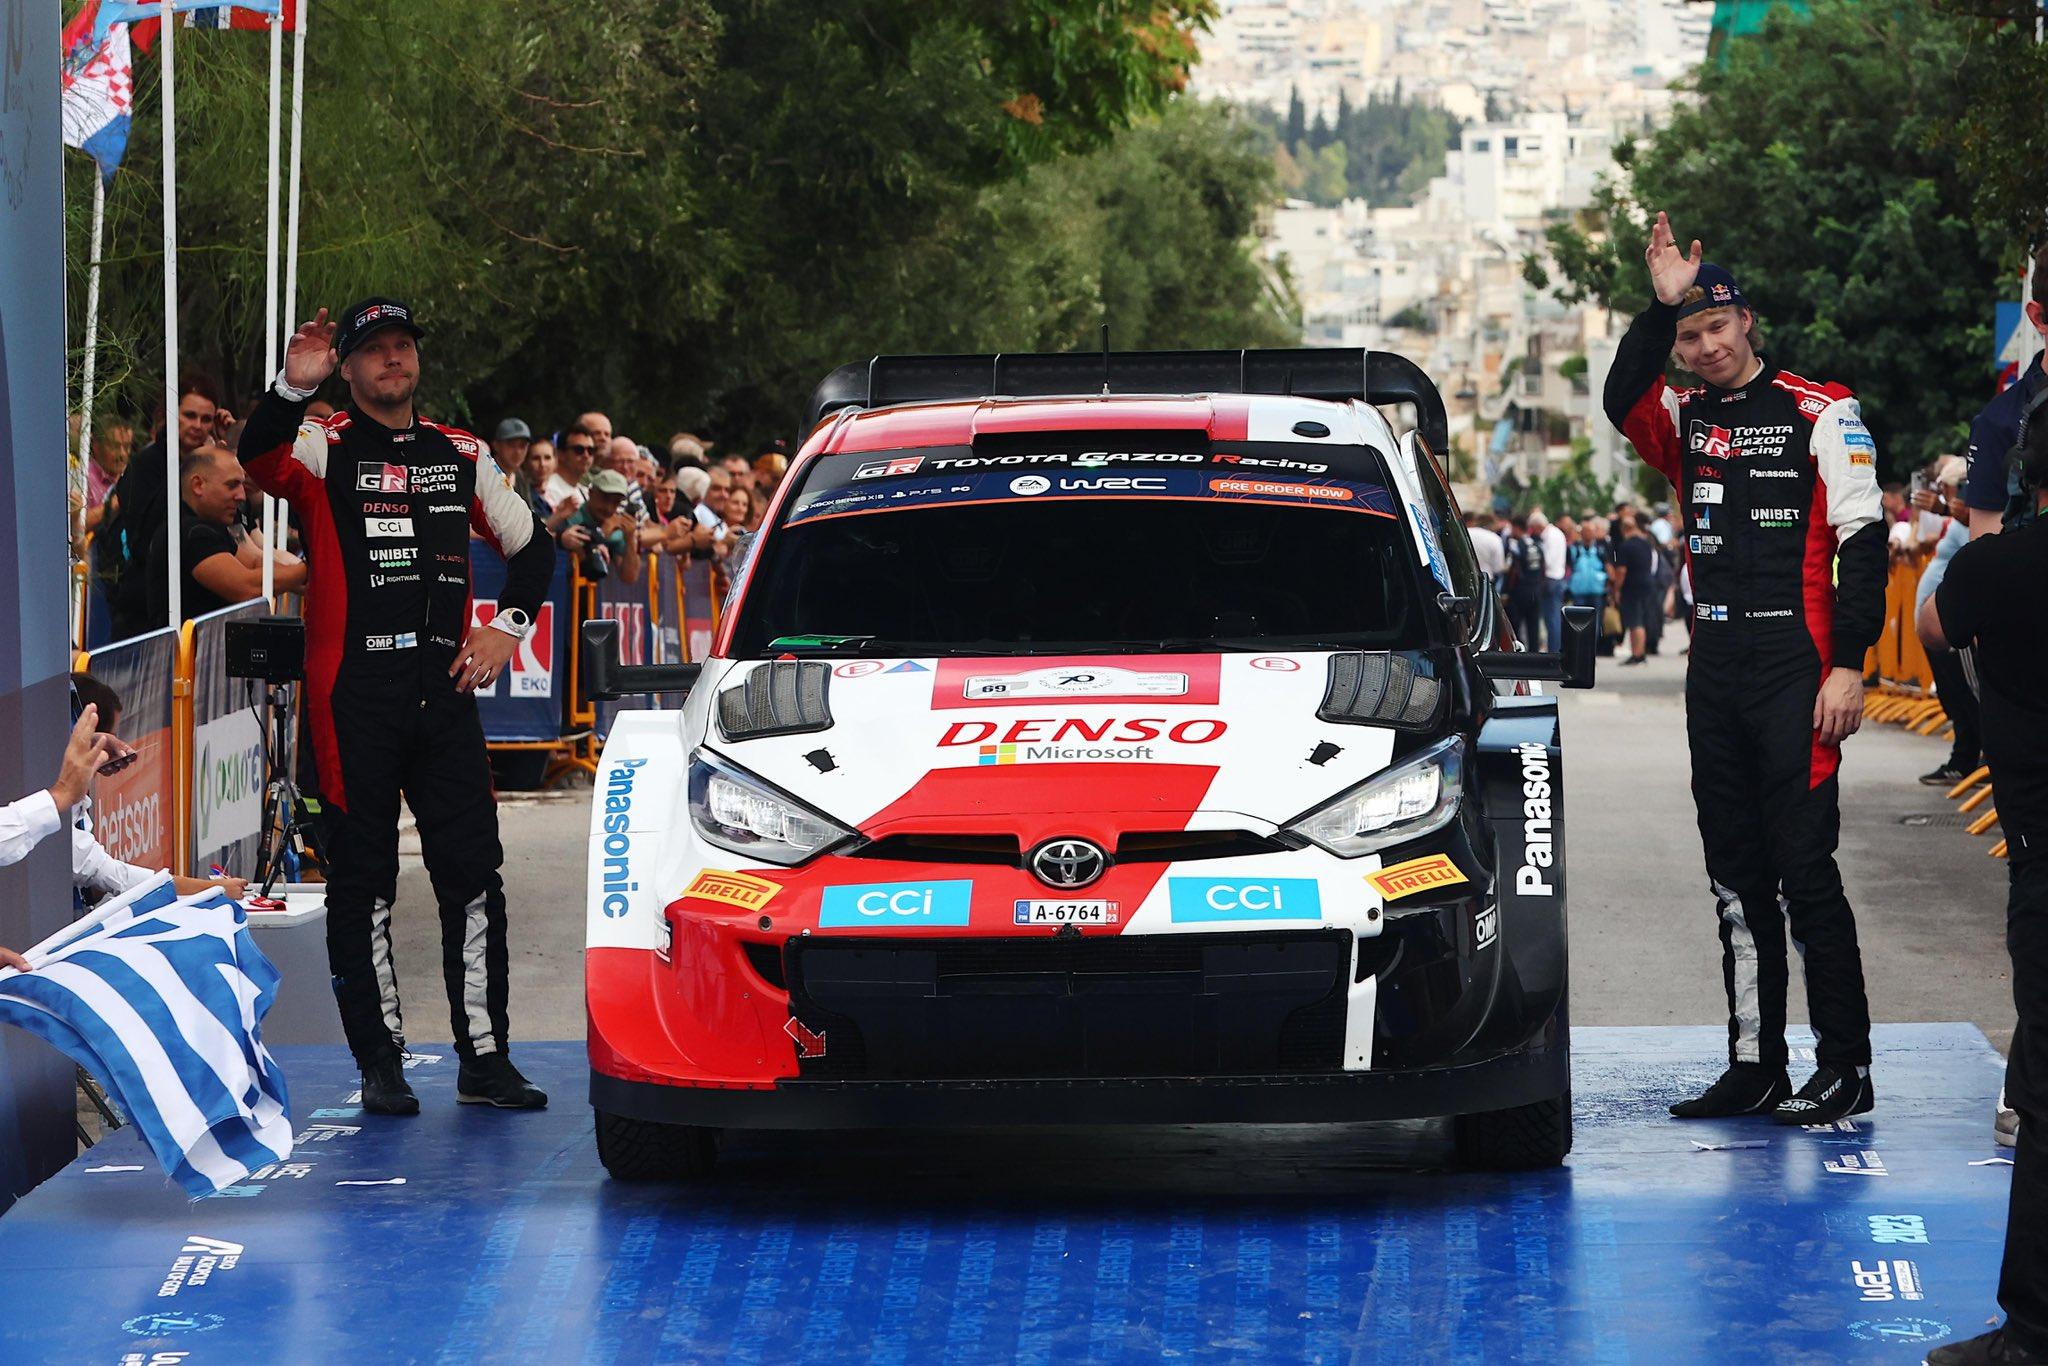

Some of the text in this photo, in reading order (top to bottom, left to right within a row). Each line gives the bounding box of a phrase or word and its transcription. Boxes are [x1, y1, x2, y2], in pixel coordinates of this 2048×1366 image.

[1800, 400, 1825, 413] OMP
[1734, 426, 1794, 436] TOYOTA
[452, 441, 477, 453] OMP
[1690, 432, 1730, 458] GR
[1731, 436, 1786, 447] GAZOO
[1731, 445, 1784, 458] Racing
[409, 464, 459, 475] TOYOTA
[857, 452, 1329, 479] GR TOYOTA GAZOO Racing
[1697, 465, 1722, 479] NSO
[410, 474, 456, 484] GAZOO
[1750, 469, 1799, 478] Panasonic
[359, 473, 405, 490] GR
[411, 482, 457, 494] Racing
[1060, 477, 1167, 490] WRC
[909, 488, 942, 496] PS5
[1219, 482, 1344, 498] PRE ORDER NOW
[363, 502, 409, 514] DENSO
[428, 504, 467, 514] Panasonic
[1751, 509, 1800, 521] UNIBET
[378, 521, 402, 533] CCi
[369, 548, 419, 561] UNIBET
[386, 574, 421, 583] RIGHTWARE
[1697, 605, 1711, 617] OMP
[366, 637, 394, 648] OMP
[521, 677, 549, 691] EKO
[981, 684, 1007, 693] 69
[936, 718, 1228, 747] DENSO
[1026, 745, 1154, 760] Microsoft
[1511, 742, 1554, 897] Panasonic
[603, 757, 648, 918] Panasonic
[1374, 859, 1458, 894] PIRELLI
[689, 874, 769, 904] PIRELLI
[856, 888, 933, 916] CCi
[1205, 884, 1282, 911] CCi
[1035, 904, 1100, 920] A-6764
[1107, 903, 1117, 911] 11
[1106, 914, 1117, 923] 23
[1476, 911, 1497, 942] OMP
